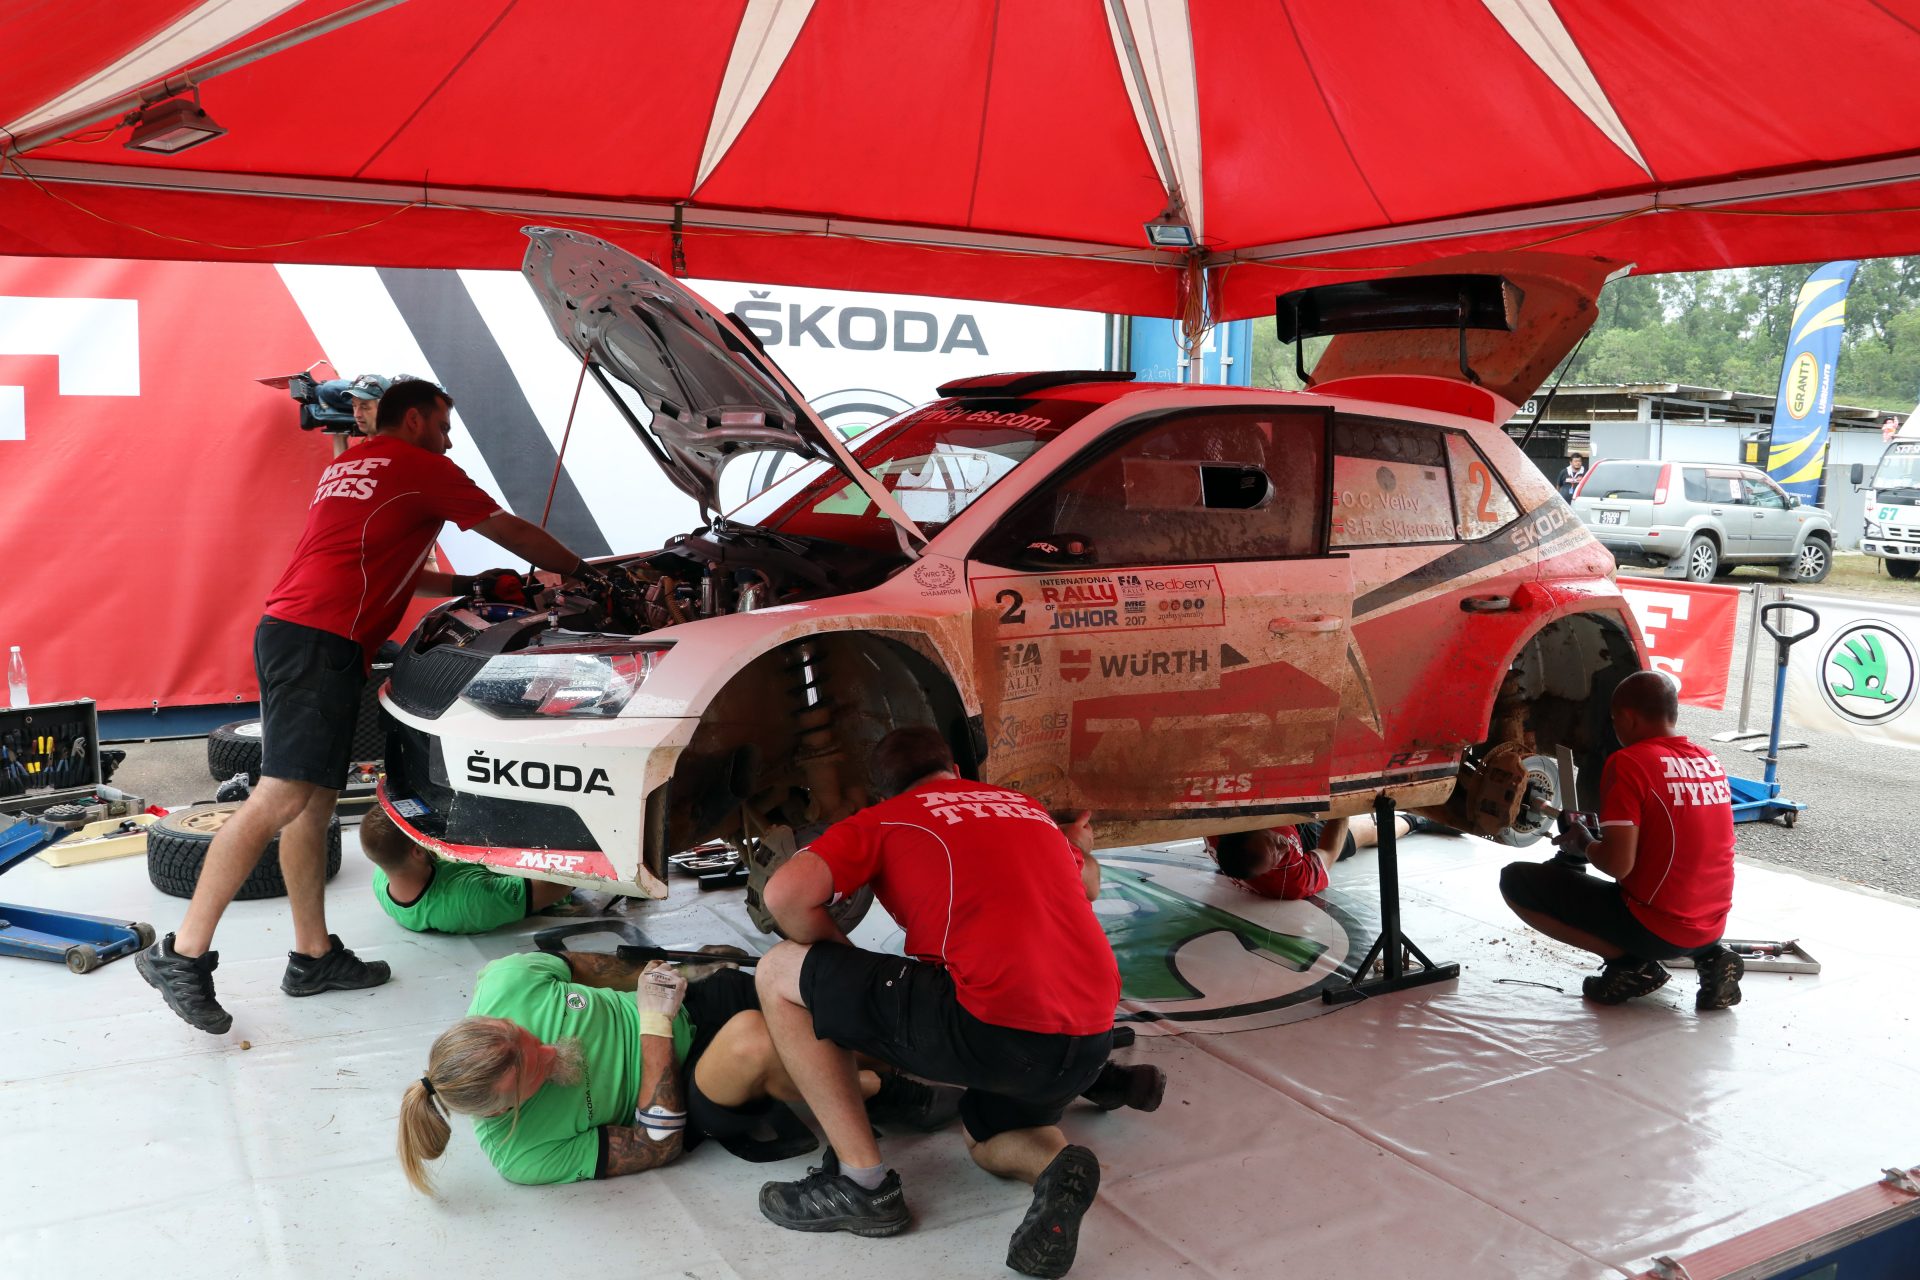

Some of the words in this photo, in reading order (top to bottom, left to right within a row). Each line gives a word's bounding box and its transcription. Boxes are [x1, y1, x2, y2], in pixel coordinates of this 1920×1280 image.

[734, 290, 989, 356] ŠKODA
[1795, 360, 1810, 412] GRANTT
[319, 457, 392, 486] MRF
[1469, 461, 1498, 522] 2
[1879, 507, 1898, 520] 67
[921, 589, 961, 597] CHAMPION
[1040, 576, 1112, 586] INTERNATIONAL
[1145, 579, 1212, 591] Redberry
[995, 589, 1026, 624] 2
[1041, 584, 1118, 608] RALLY
[1049, 610, 1118, 630] JOHOR
[1125, 616, 1146, 626] 2017
[1100, 649, 1208, 679] WÜRTH
[467, 750, 615, 796] ŠKODA
[930, 802, 1059, 831] TYRES
[516, 851, 584, 872] MRF
